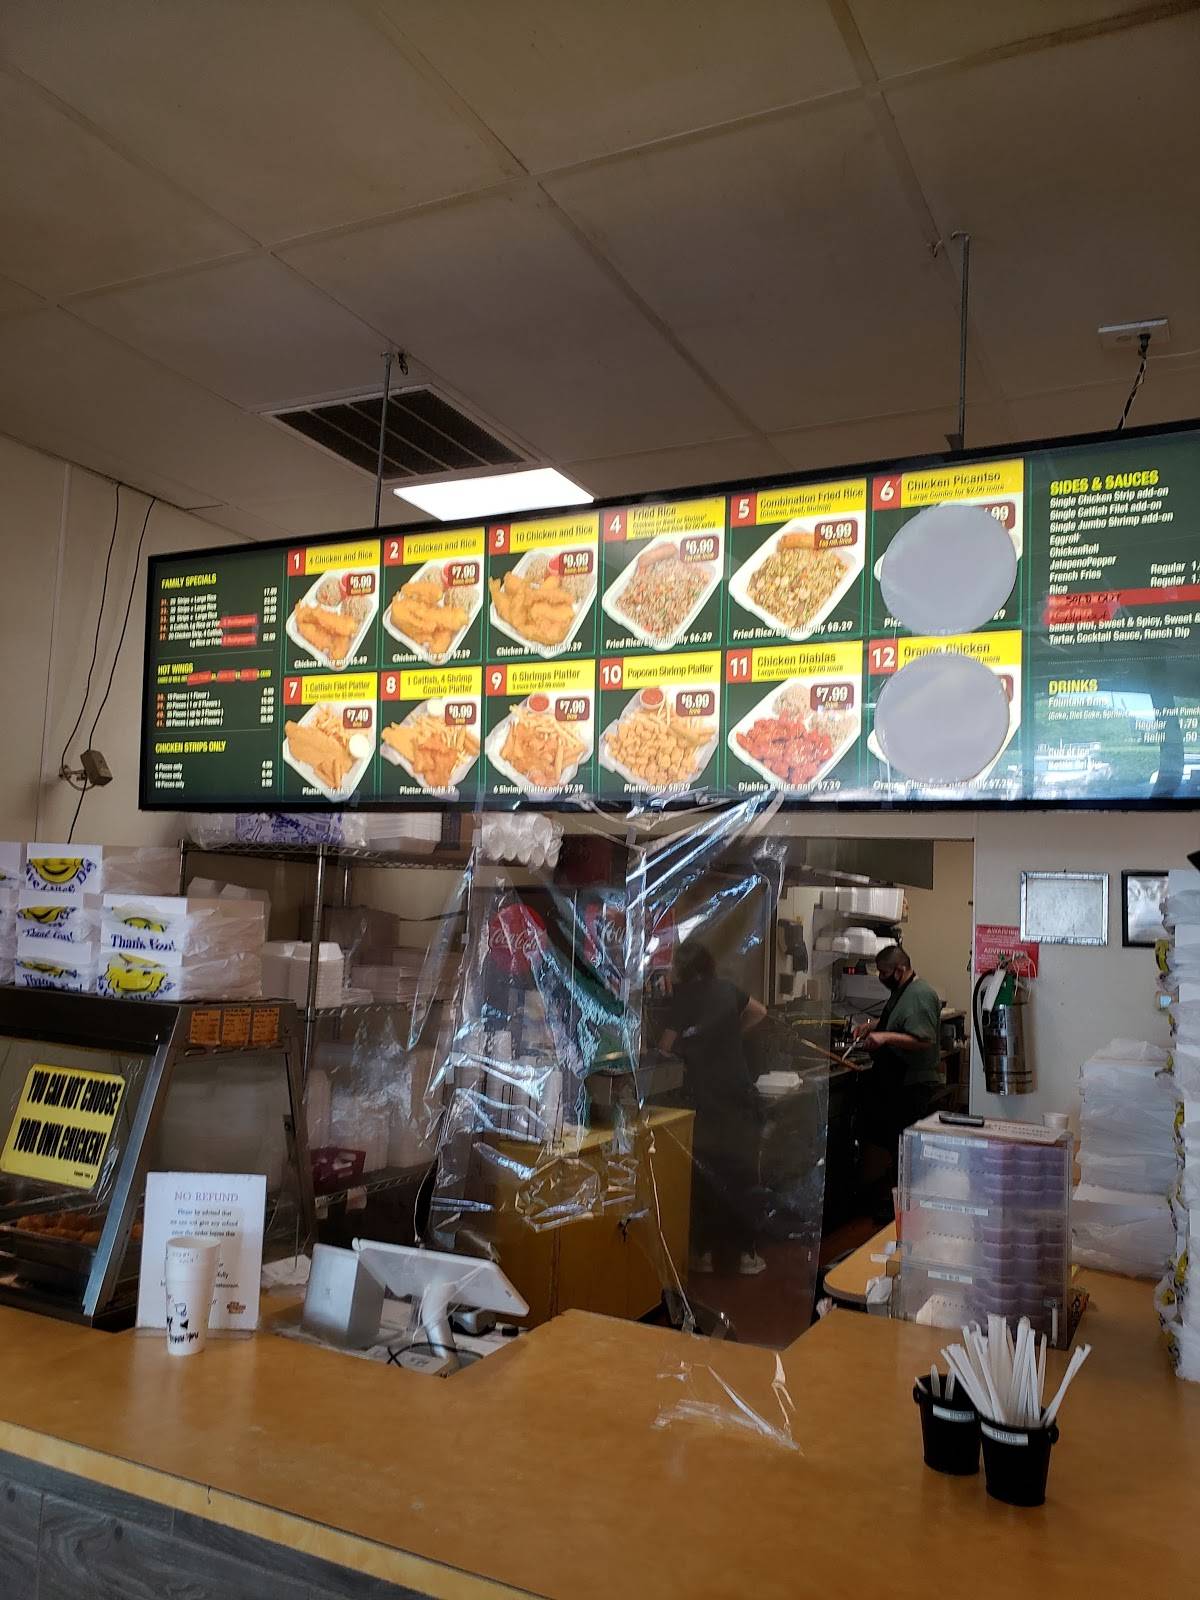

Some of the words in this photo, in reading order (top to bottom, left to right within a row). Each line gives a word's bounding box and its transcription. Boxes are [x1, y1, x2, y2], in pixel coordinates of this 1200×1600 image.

[879, 480, 895, 502] 6
[907, 477, 951, 492] Chicken
[1050, 477, 1089, 496] SIDES
[1091, 476, 1102, 492] &
[1104, 469, 1160, 490] SAUCES
[760, 494, 816, 509] Combination
[818, 490, 841, 501] Fried
[843, 487, 863, 498] Rice
[1050, 496, 1077, 509] Single
[1078, 492, 1112, 506] Chicken
[1113, 489, 1136, 502] Strip
[1136, 486, 1169, 499] add-on
[633, 507, 655, 521] Fried
[657, 506, 677, 517] Rice
[738, 498, 750, 519] 5
[1050, 508, 1077, 521] Single
[1077, 505, 1108, 519] Catfish
[1109, 502, 1129, 515] Filet
[1130, 500, 1162, 513] add-on
[609, 514, 621, 534] 4
[1049, 521, 1076, 534] Single
[1077, 518, 1107, 531] Jumbo
[1108, 515, 1140, 528] Shrimp
[1141, 512, 1174, 525] add-on
[494, 528, 505, 548] 3
[516, 533, 525, 543] 10
[526, 529, 557, 541] Chicken
[559, 526, 574, 537] and
[575, 525, 593, 536] Rice
[389, 541, 399, 560] 2
[413, 541, 442, 554] Chicken
[444, 540, 459, 550] and
[460, 538, 477, 549] Rice
[294, 552, 300, 570] 1
[315, 554, 342, 564] Chicken
[1049, 571, 1079, 583] French
[1081, 569, 1102, 580] Fries
[1150, 562, 1186, 576] Regular
[161, 577, 184, 589] FAMILY
[185, 572, 217, 587] SPECIALS
[1150, 575, 1186, 588] Regular
[1049, 584, 1069, 595] Rice
[1098, 617, 1126, 630] Sweet
[1136, 615, 1163, 628] Spicy,
[1164, 612, 1192, 625] Sweet
[732, 627, 754, 640] Fried
[1049, 634, 1076, 646] Tartar,
[1077, 631, 1112, 643] Cocktail
[1113, 629, 1143, 642] Sauce,
[1144, 628, 1173, 640] Ranch
[1174, 626, 1191, 639] Dip
[605, 638, 625, 650] Fried
[757, 656, 796, 668] Chicken
[799, 652, 836, 665] Diablas
[871, 646, 896, 668] 12
[157, 664, 171, 676] HOT
[171, 662, 194, 674] WINGS
[553, 669, 581, 680] Platter
[602, 665, 622, 685] 10
[627, 667, 658, 679] Popcorn
[659, 665, 686, 677] Shrimp
[688, 664, 713, 676] Platter
[730, 657, 748, 677] 11
[309, 681, 332, 692] Catfish
[348, 679, 371, 690] Platter
[385, 676, 397, 694] 8
[447, 673, 473, 683] Shrimp
[491, 671, 503, 690] 9
[1048, 678, 1098, 695] DRINKS
[289, 681, 298, 699] 7
[422, 685, 447, 695] Combo
[448, 684, 473, 694] Platter
[155, 742, 183, 754] CHICKEN
[184, 741, 208, 753] STRIPS
[208, 741, 226, 752] ONLY
[400, 786, 422, 796] Platter
[499, 784, 522, 795] Shrimp
[623, 783, 649, 793] Platter
[738, 781, 769, 792] Diablas
[27, 1070, 51, 1104] YOU
[43, 1072, 68, 1107] CAN
[60, 1075, 87, 1110] NOT
[79, 1078, 122, 1117] CHOOSE
[13, 1117, 42, 1154] YOUR
[36, 1121, 64, 1158] OWN
[174, 1191, 191, 1201] NO
[195, 1191, 239, 1202] REFUND
